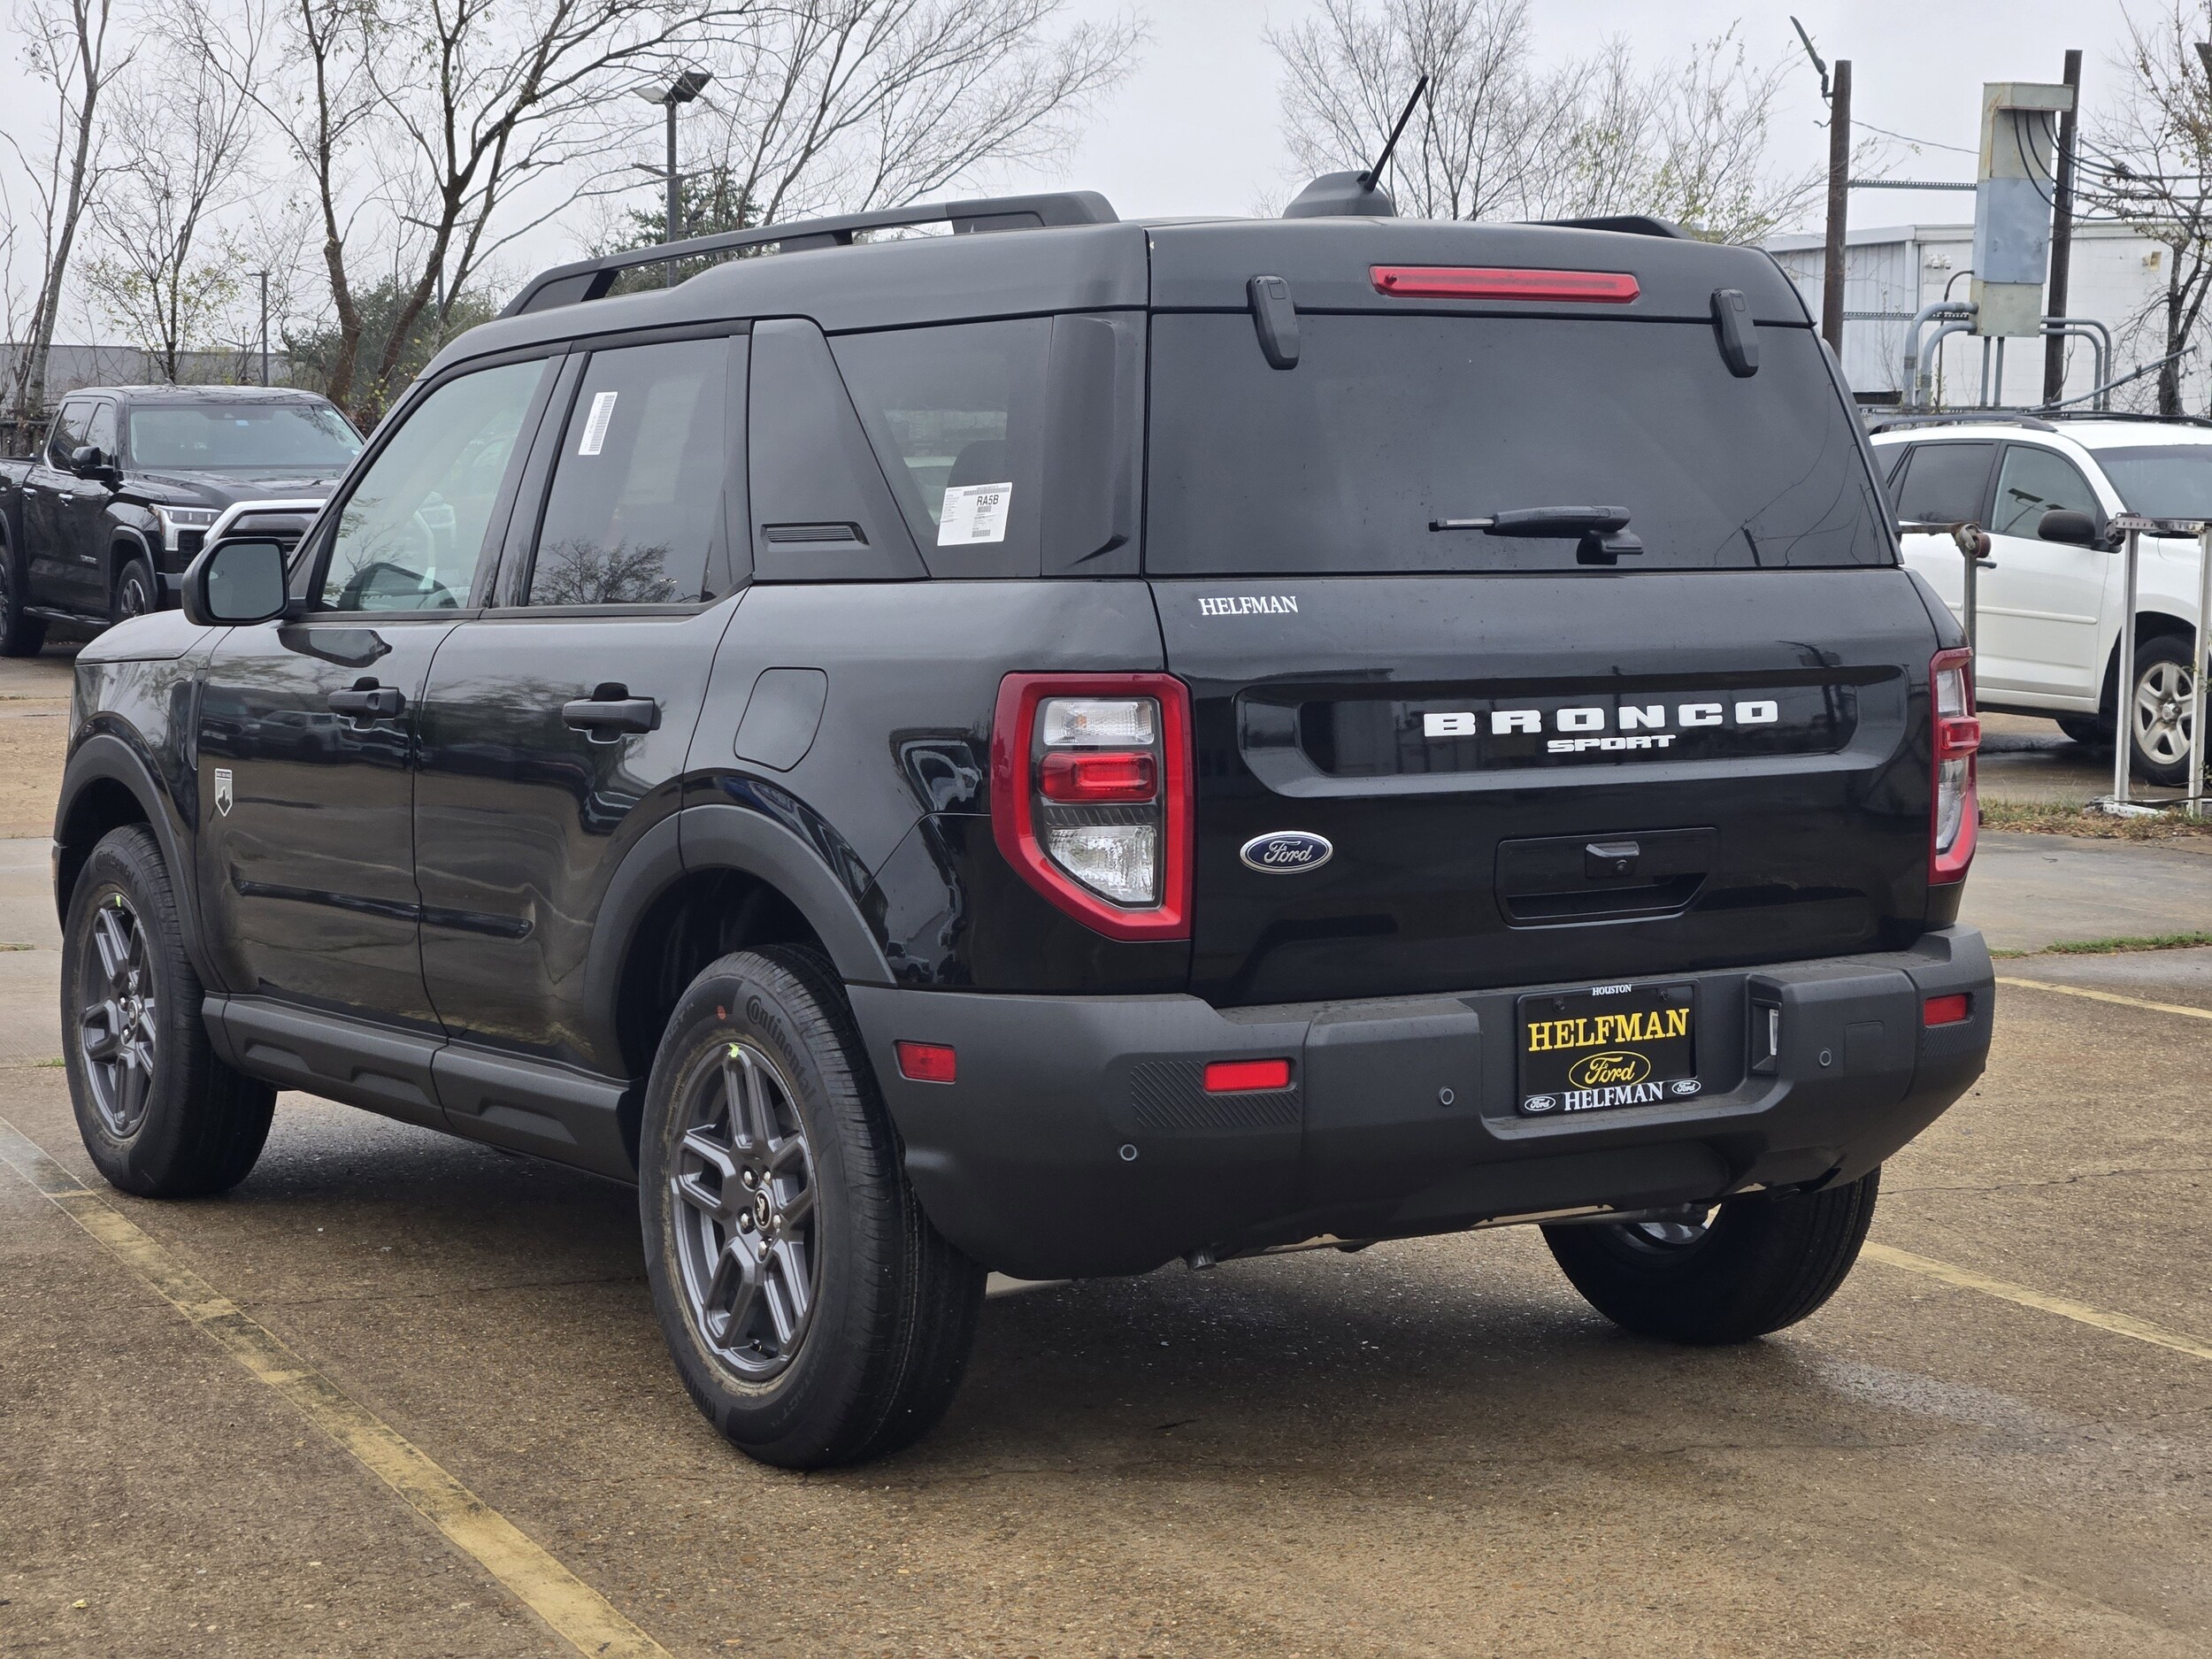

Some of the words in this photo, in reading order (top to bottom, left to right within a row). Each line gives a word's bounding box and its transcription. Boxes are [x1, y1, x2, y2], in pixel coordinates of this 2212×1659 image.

[977, 494, 999, 506] RA5B
[1198, 595, 1298, 615] HELFMAN
[1424, 700, 1779, 737] BRONCO
[1547, 734, 1677, 754] SPORT
[1263, 840, 1313, 864] Ford
[1592, 984, 1632, 996] HOUSTON
[1527, 1008, 1690, 1051] HELFMAN
[746, 995, 817, 1102] Continental
[1584, 1056, 1636, 1085] Ford
[1563, 1081, 1664, 1111] HELFMAN
